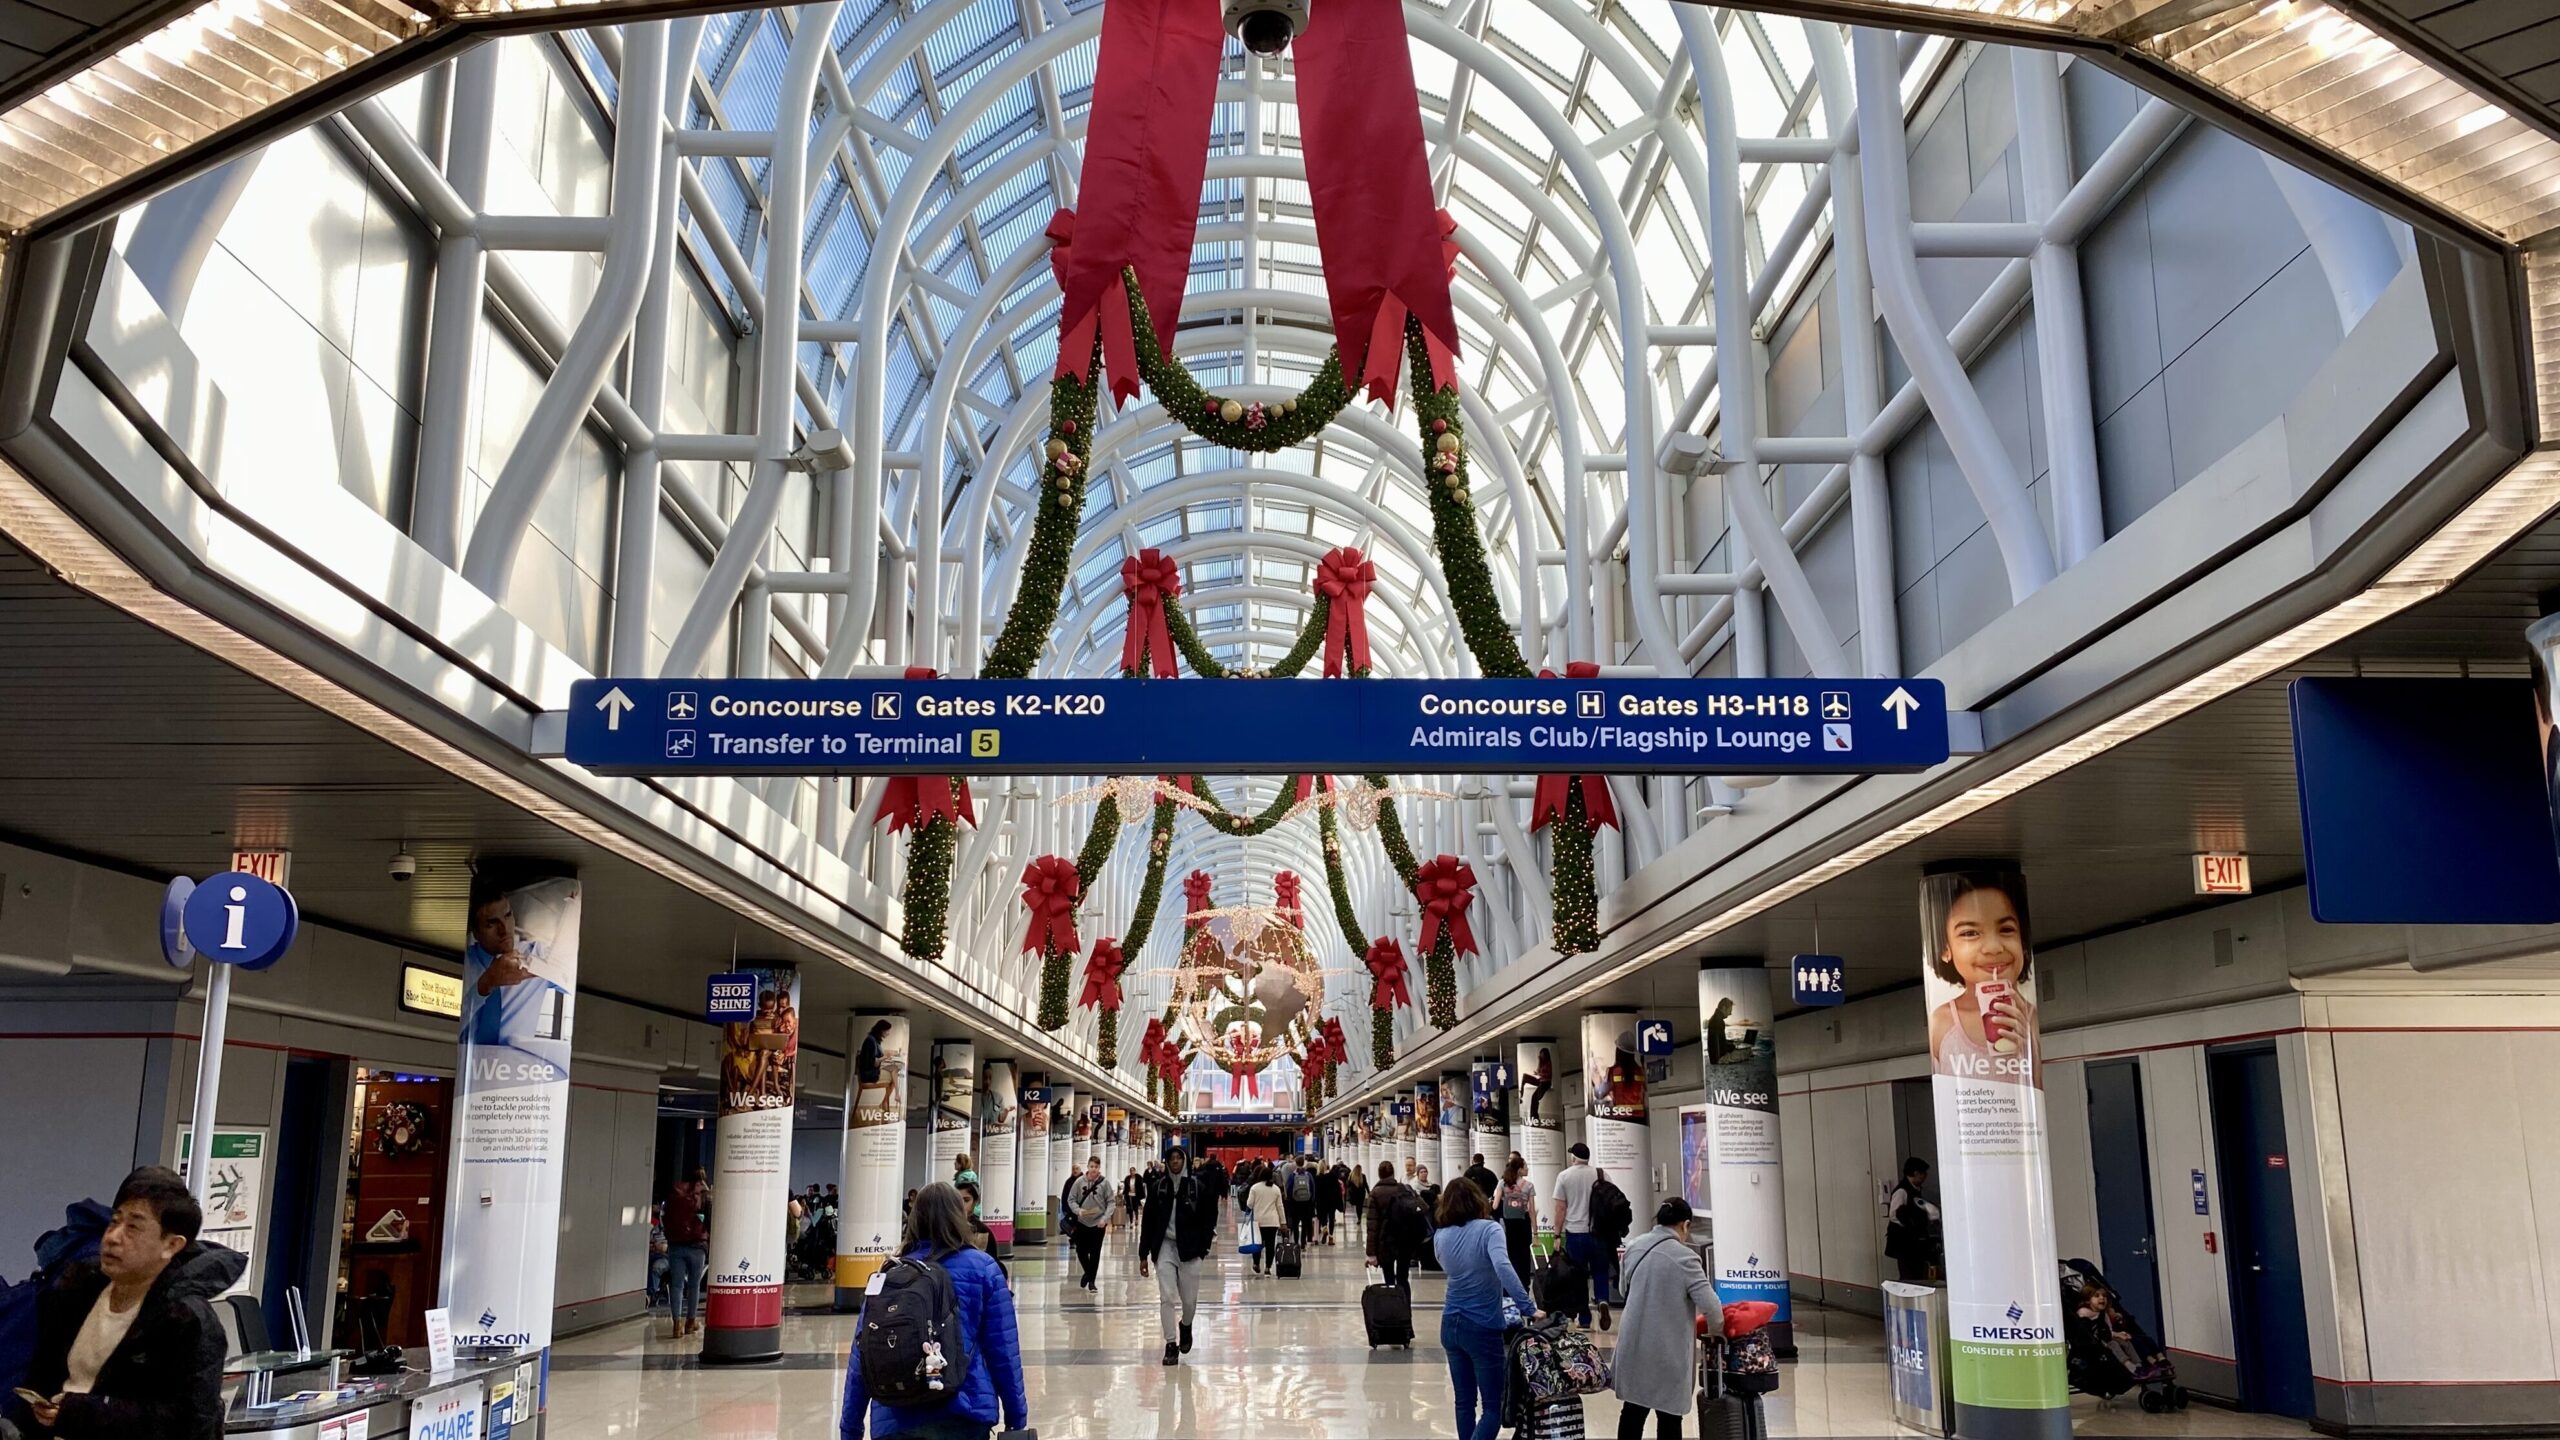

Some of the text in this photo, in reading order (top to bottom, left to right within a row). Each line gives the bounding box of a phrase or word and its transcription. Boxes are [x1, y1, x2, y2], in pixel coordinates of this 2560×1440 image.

[710, 695, 1106, 717] Concourse K Gates K2-K20
[1420, 694, 1809, 716] Concourse H Gates H3-H18
[708, 733, 994, 754] Transfer to Terminal 5
[1410, 726, 1811, 753] Admirals Club/Flagship Lounge
[236, 853, 280, 881] EXIT
[2204, 857, 2242, 884] EXIT
[712, 986, 751, 997] SHOE
[710, 999, 752, 1010] SHINE
[472, 1058, 555, 1081] We see
[1950, 1053, 2031, 1075] We see
[1024, 1090, 1040, 1101] K2
[1714, 1089, 1769, 1105] We see
[1972, 1088, 1995, 1097] safety
[481, 1094, 551, 1103] engineers suddenly
[729, 1091, 784, 1108] We see
[1978, 1097, 2016, 1106] becoming
[493, 1103, 517, 1111] tackle
[518, 1103, 551, 1112] problems
[1400, 1105, 1411, 1113] H3
[1594, 1104, 1633, 1116] We see
[471, 1112, 513, 1122] completely
[860, 1109, 899, 1121] We see
[935, 1119, 967, 1129] We see
[1479, 1123, 1491, 1132] We
[1525, 1117, 1556, 1127] We see
[986, 1124, 1013, 1134] We see
[716, 1273, 772, 1284] EMERSON
[1726, 1269, 1780, 1279] EMERSON
[752, 1287, 778, 1295] SOLVED
[1720, 1282, 1752, 1290] CONSIDER
[1973, 1326, 2054, 1340] EMERSON
[452, 1333, 530, 1346] MERSON
[1961, 1345, 2063, 1357] CONSIDER IT SOLVED
[1893, 1344, 1924, 1370] O'HARE
[419, 1410, 475, 1440] O'HARE
